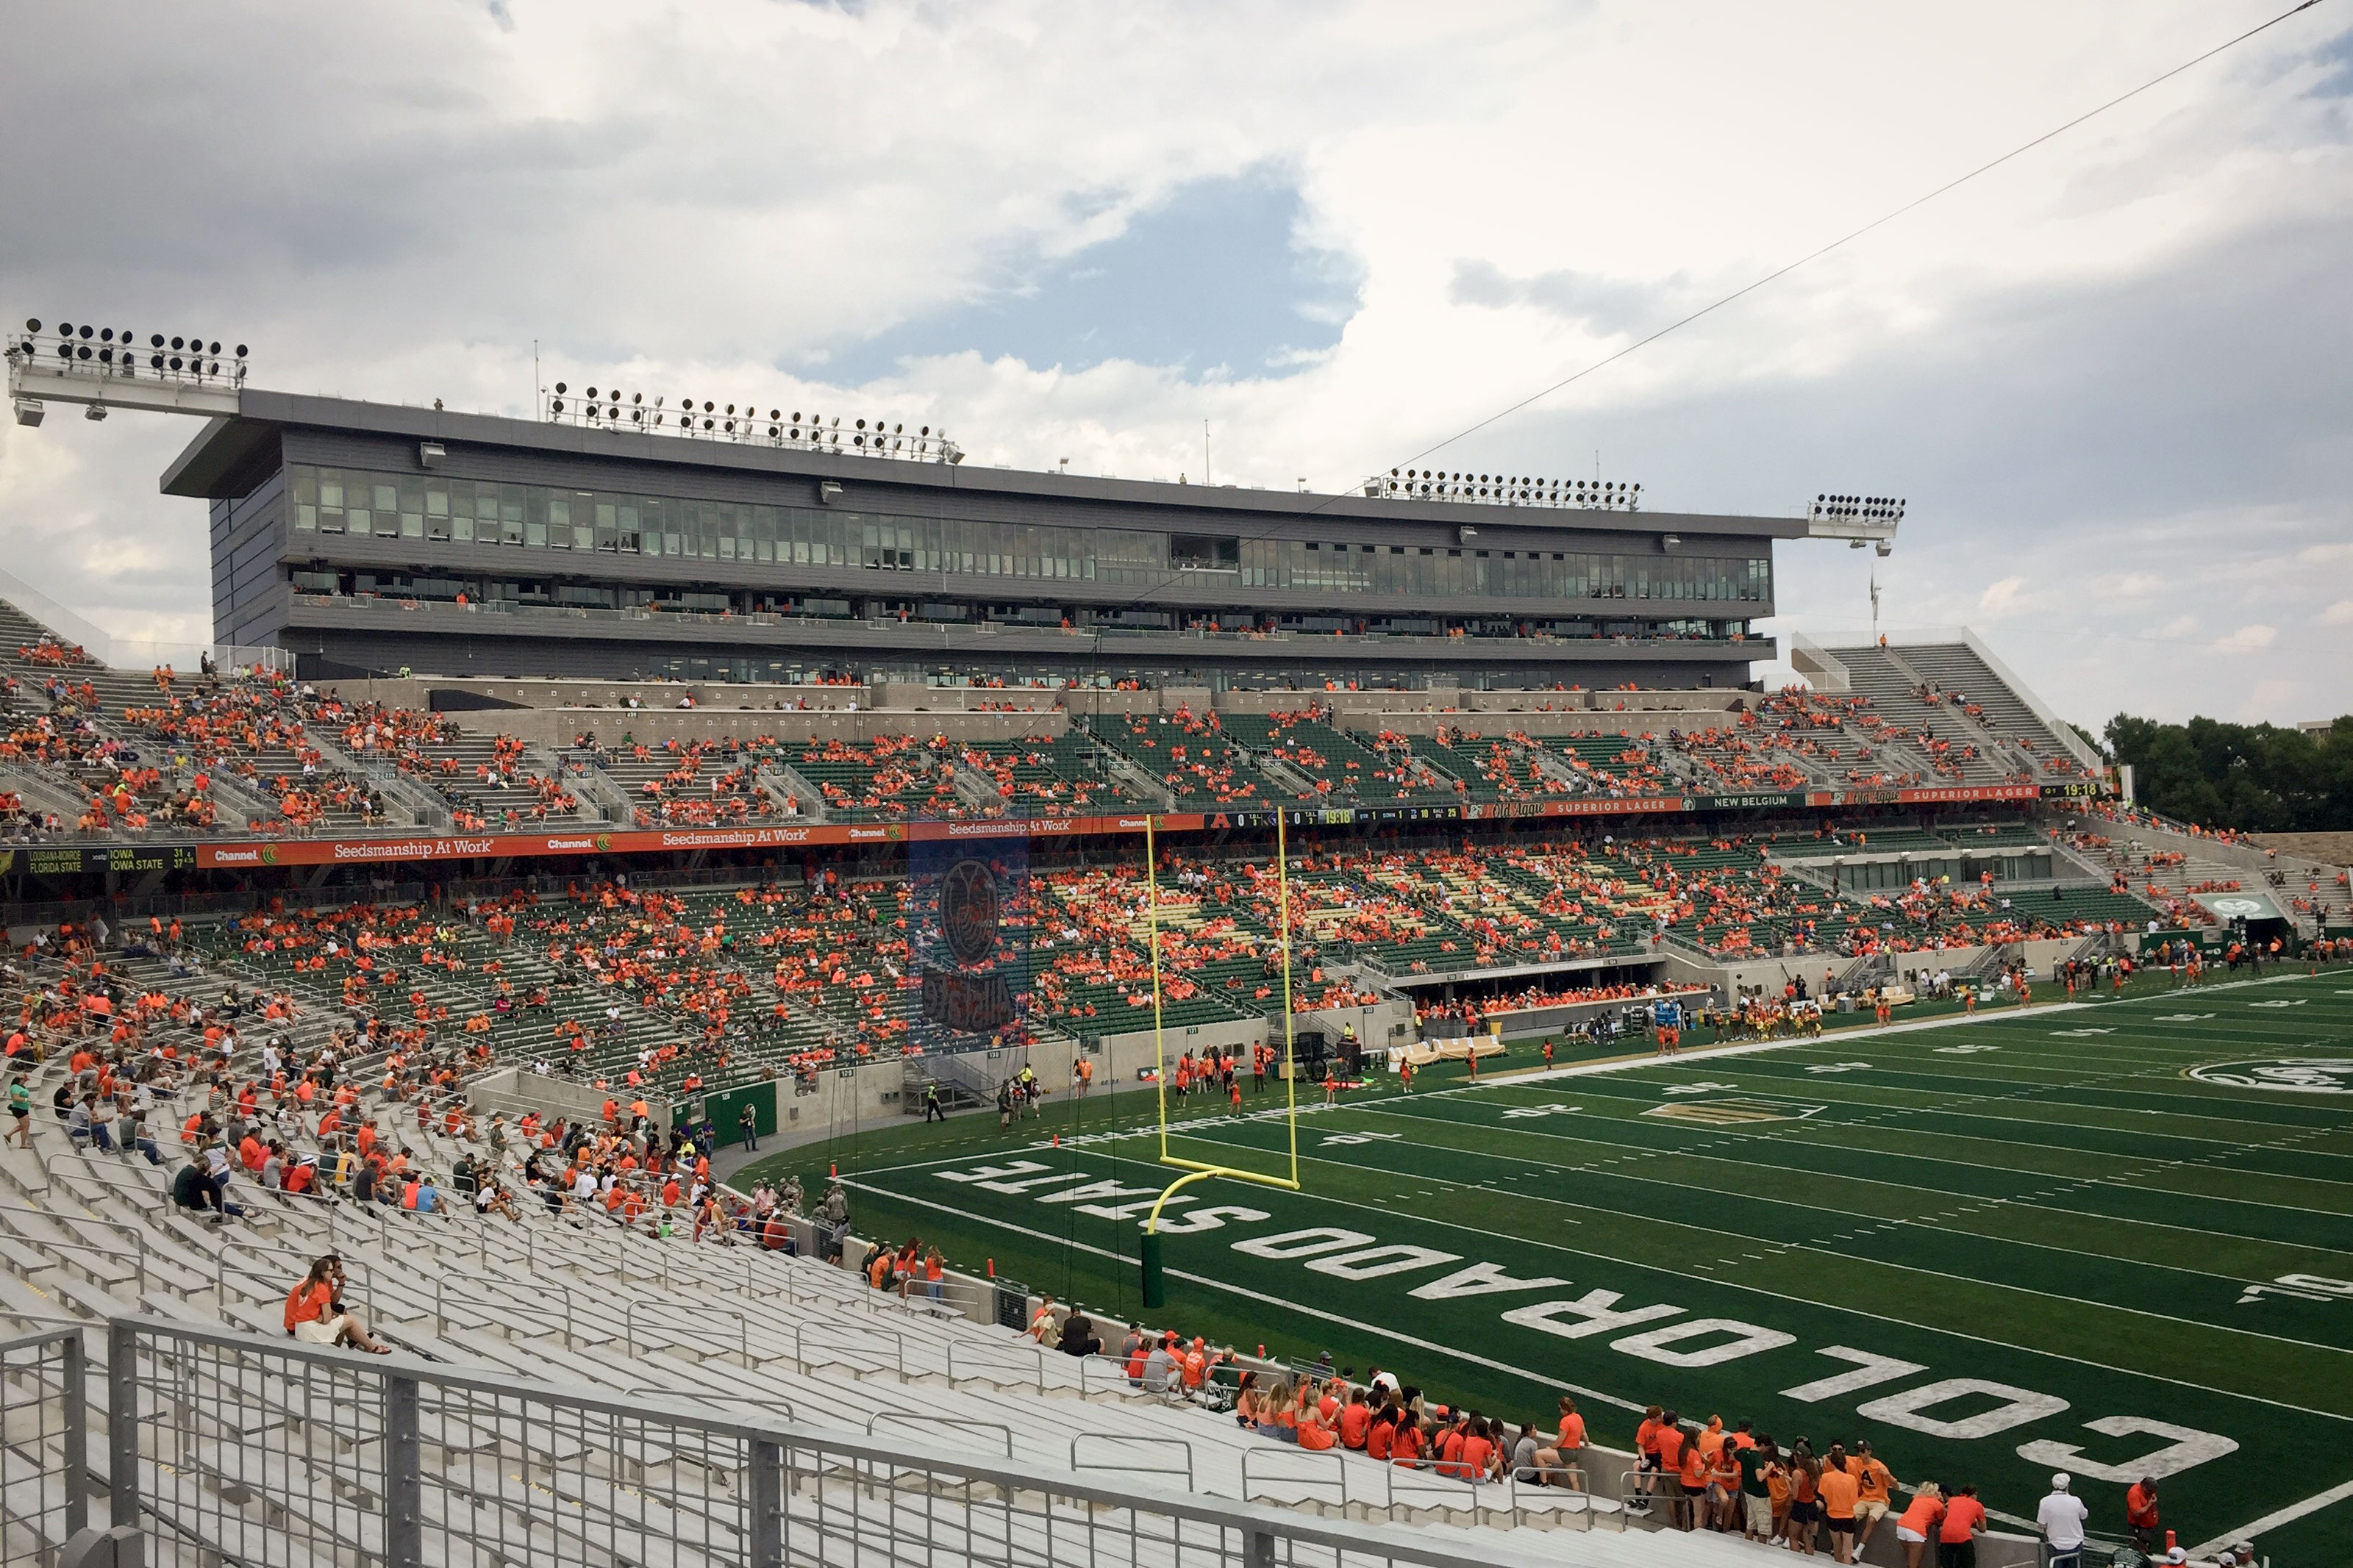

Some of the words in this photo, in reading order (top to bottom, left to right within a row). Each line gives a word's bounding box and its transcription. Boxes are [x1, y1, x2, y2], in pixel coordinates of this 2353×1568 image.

[1872, 790, 1902, 803] Aggie
[1913, 790, 1979, 800] SUPERIOR
[1986, 787, 2033, 798] LAGER
[2064, 784, 2097, 796] 19:18
[1557, 801, 1621, 813] SUPERIOR
[1627, 800, 1665, 811] LAGER
[1715, 797, 1739, 807] NEW
[1741, 795, 1788, 806] BELGIUM
[1399, 810, 1402, 819] 1
[1421, 809, 1428, 818] 10
[1448, 809, 1456, 817] 25
[1493, 803, 1511, 817] Old
[1513, 801, 1546, 817] Aggie
[1324, 810, 1351, 824] 19:18
[1372, 812, 1376, 820] 1
[949, 822, 1026, 835] Seedsmanship
[1029, 821, 1041, 831] At
[663, 831, 755, 846] Seedsmanship
[757, 829, 774, 842] At
[110, 849, 134, 859] IOWA
[174, 848, 183, 857] 31
[335, 843, 432, 859] Seedsmanship
[435, 841, 451, 854] At
[30, 862, 59, 873] FLORIDA
[61, 862, 81, 872] STATE
[110, 860, 134, 870] IOWA
[136, 859, 163, 869] STATE
[174, 859, 183, 868] 37
[1665, 1081, 1738, 1093] 30
[1503, 1104, 1582, 1117] 20
[1323, 1131, 1404, 1144] 10
[931, 1160, 1272, 1234] STATE
[1231, 1227, 2240, 1483] COLORADO
[1860, 1470, 1876, 1492] A
